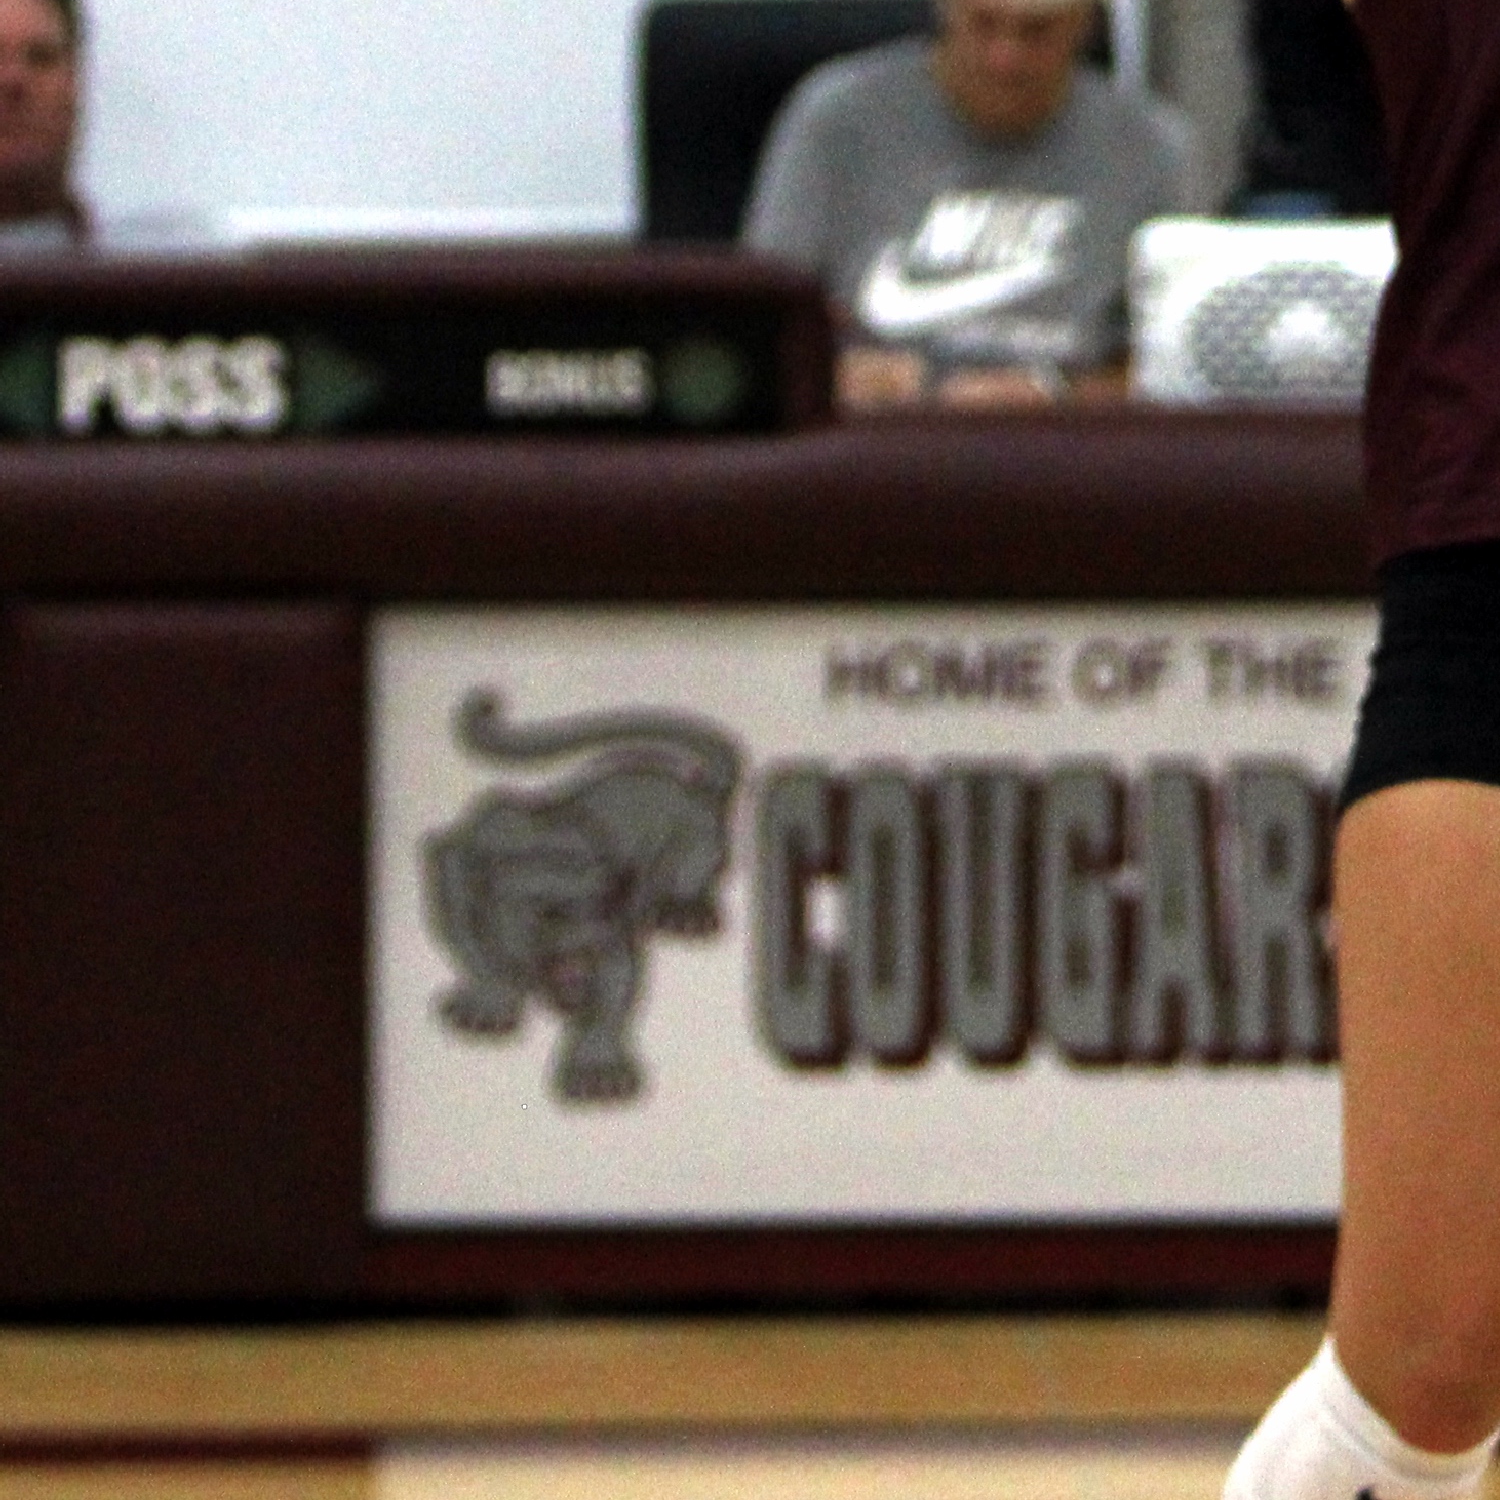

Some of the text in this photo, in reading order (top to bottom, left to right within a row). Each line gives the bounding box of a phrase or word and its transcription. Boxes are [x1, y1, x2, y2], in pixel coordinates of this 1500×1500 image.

[58, 336, 286, 432] POSS
[825, 639, 1340, 704] HOME OF THE
